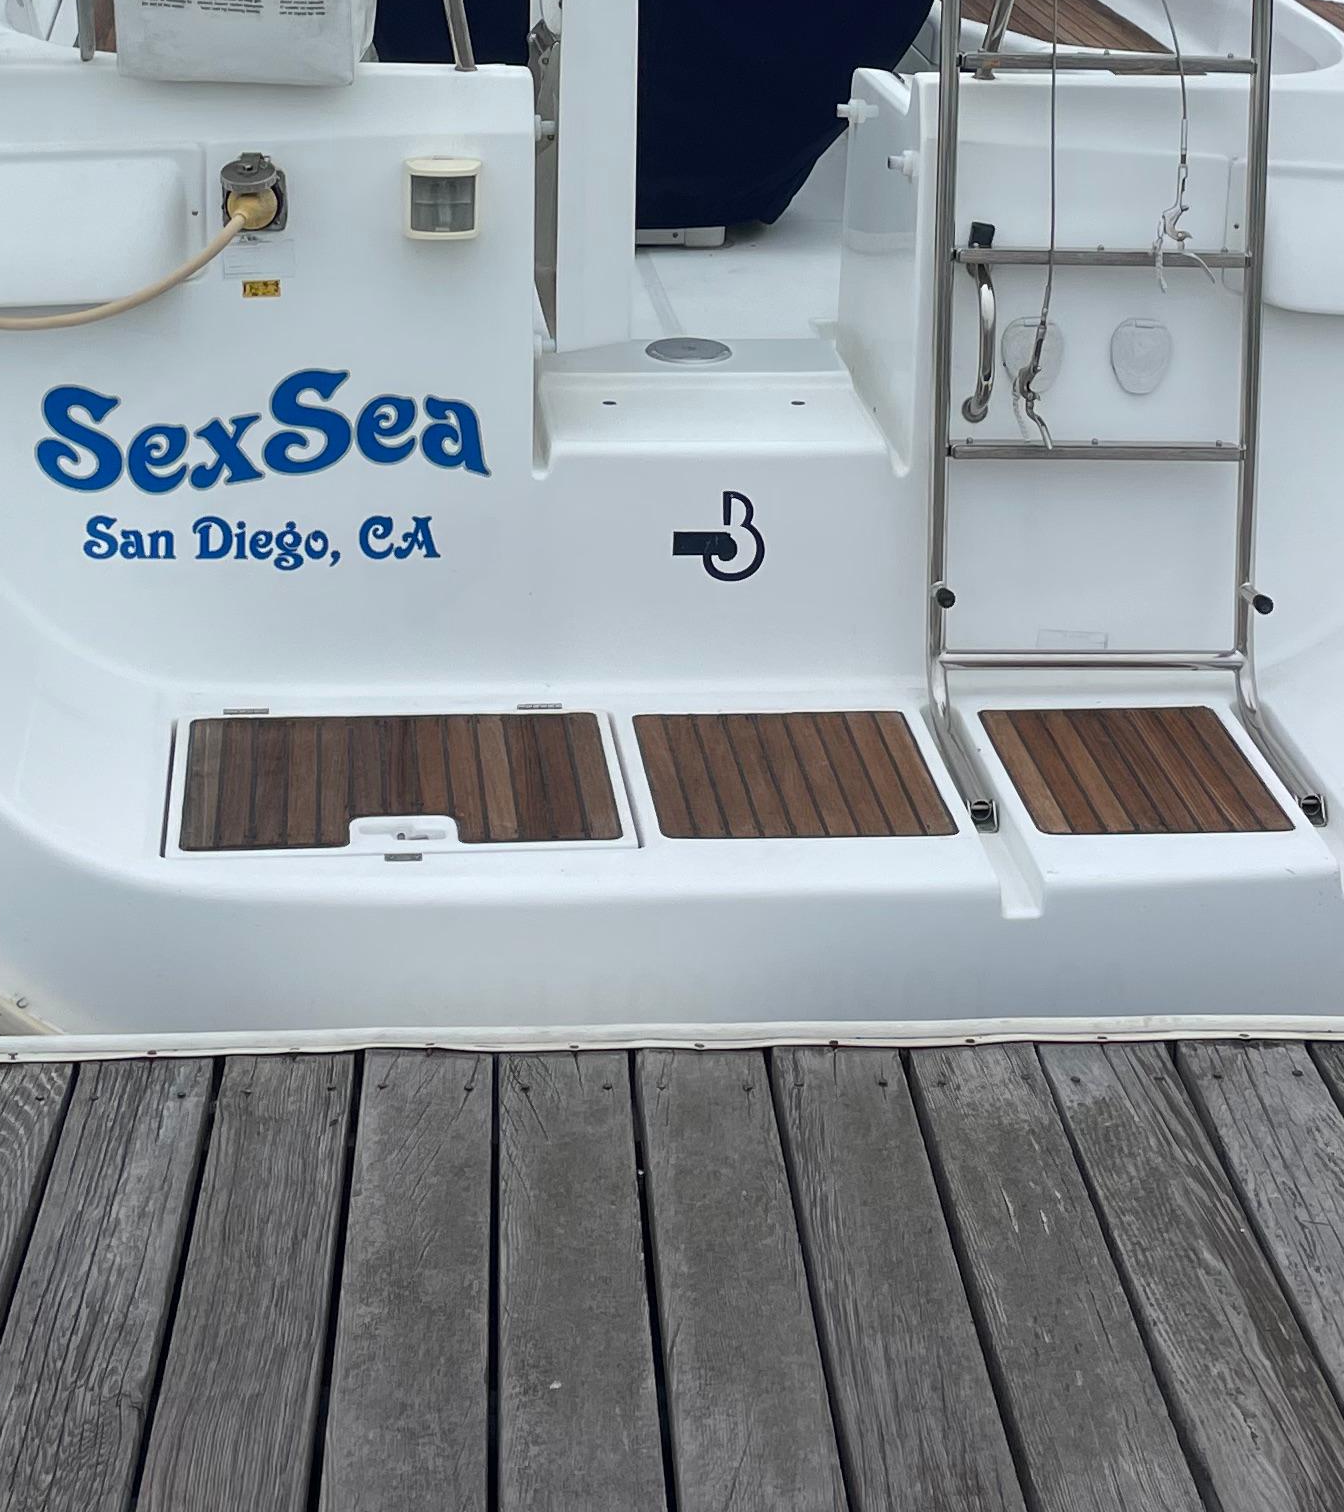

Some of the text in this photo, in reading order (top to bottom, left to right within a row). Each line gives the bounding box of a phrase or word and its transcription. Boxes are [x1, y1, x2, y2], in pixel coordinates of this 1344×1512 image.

[33, 367, 492, 497] SexSea
[84, 516, 440, 570] San Diego, CA
